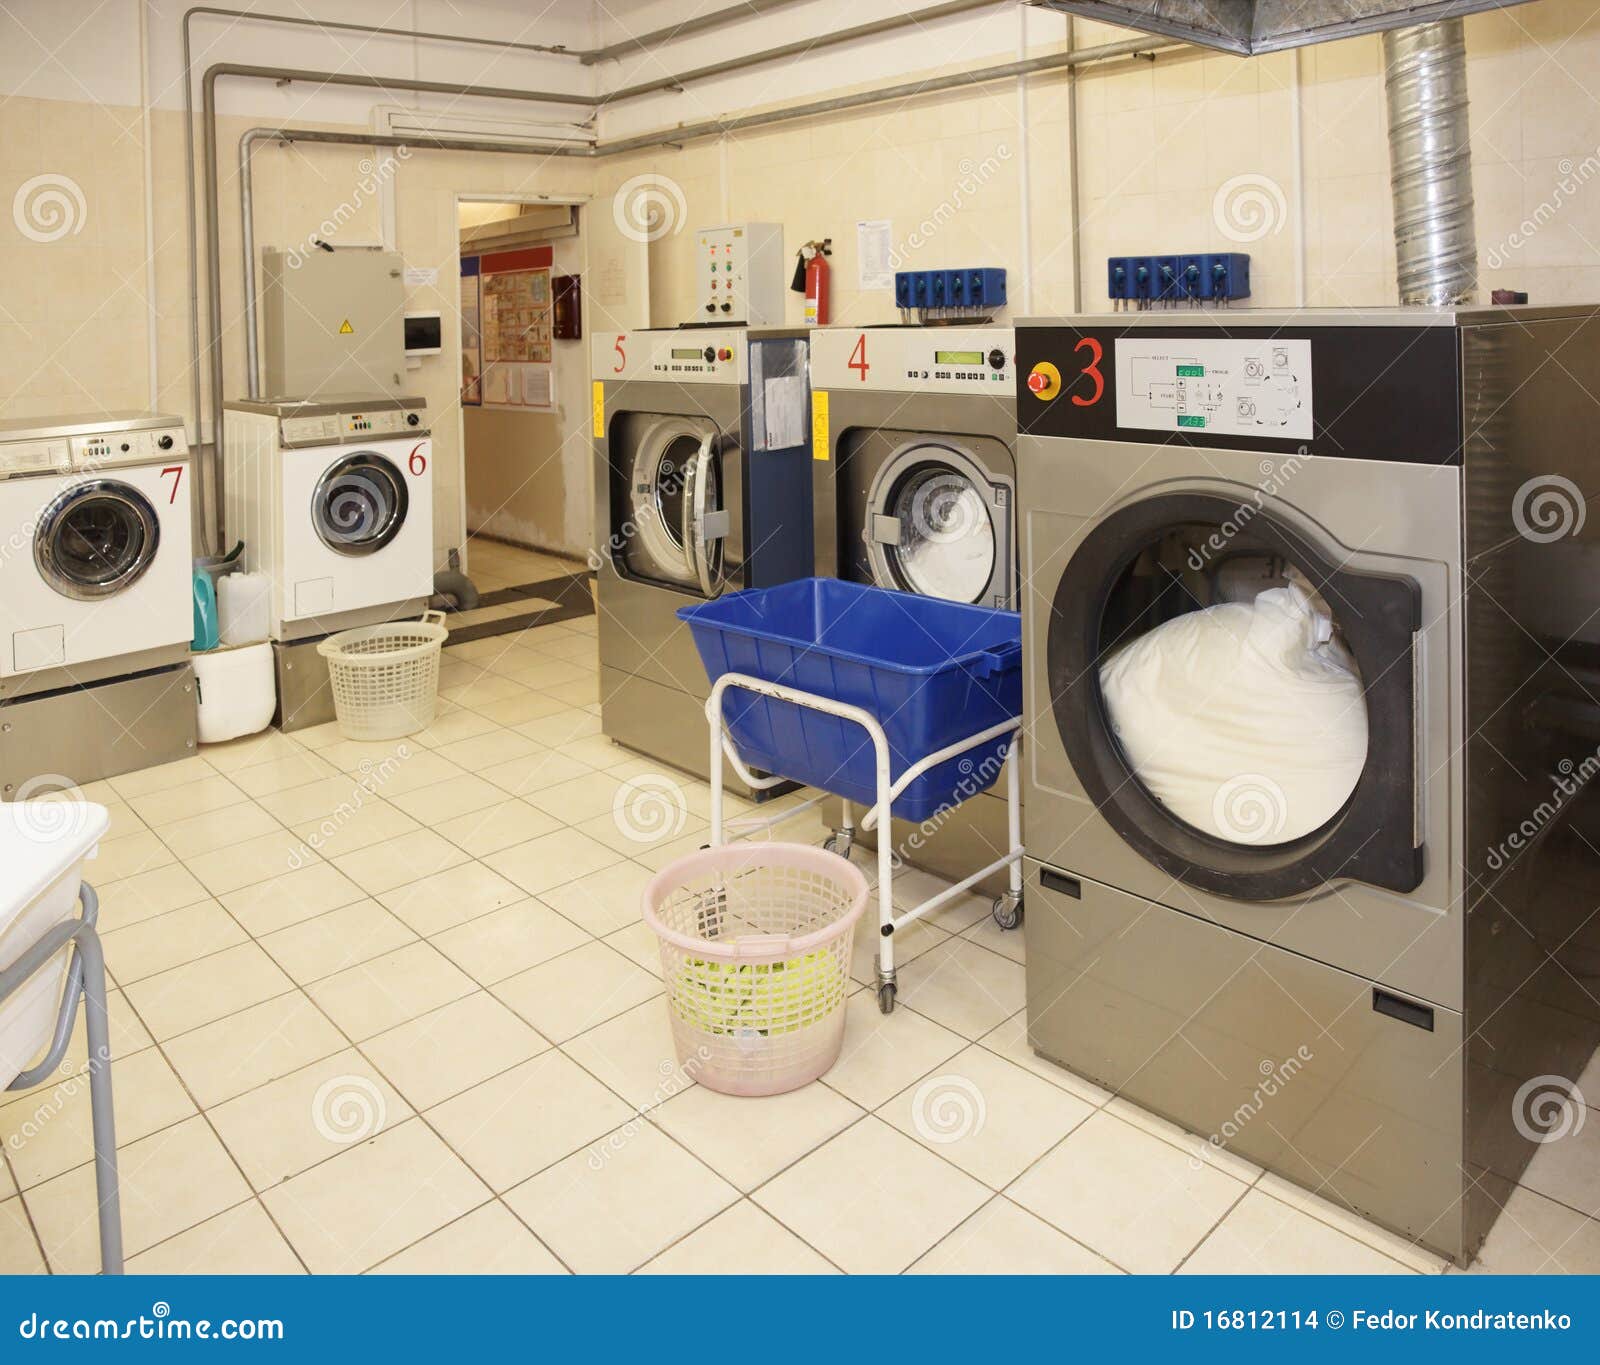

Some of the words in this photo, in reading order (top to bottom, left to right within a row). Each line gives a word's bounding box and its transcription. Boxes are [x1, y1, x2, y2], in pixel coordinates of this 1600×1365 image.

[613, 335, 626, 373] 5
[848, 333, 870, 382] 4
[1071, 337, 1105, 406] 3
[408, 442, 426, 476] 6
[160, 466, 183, 504] 7
